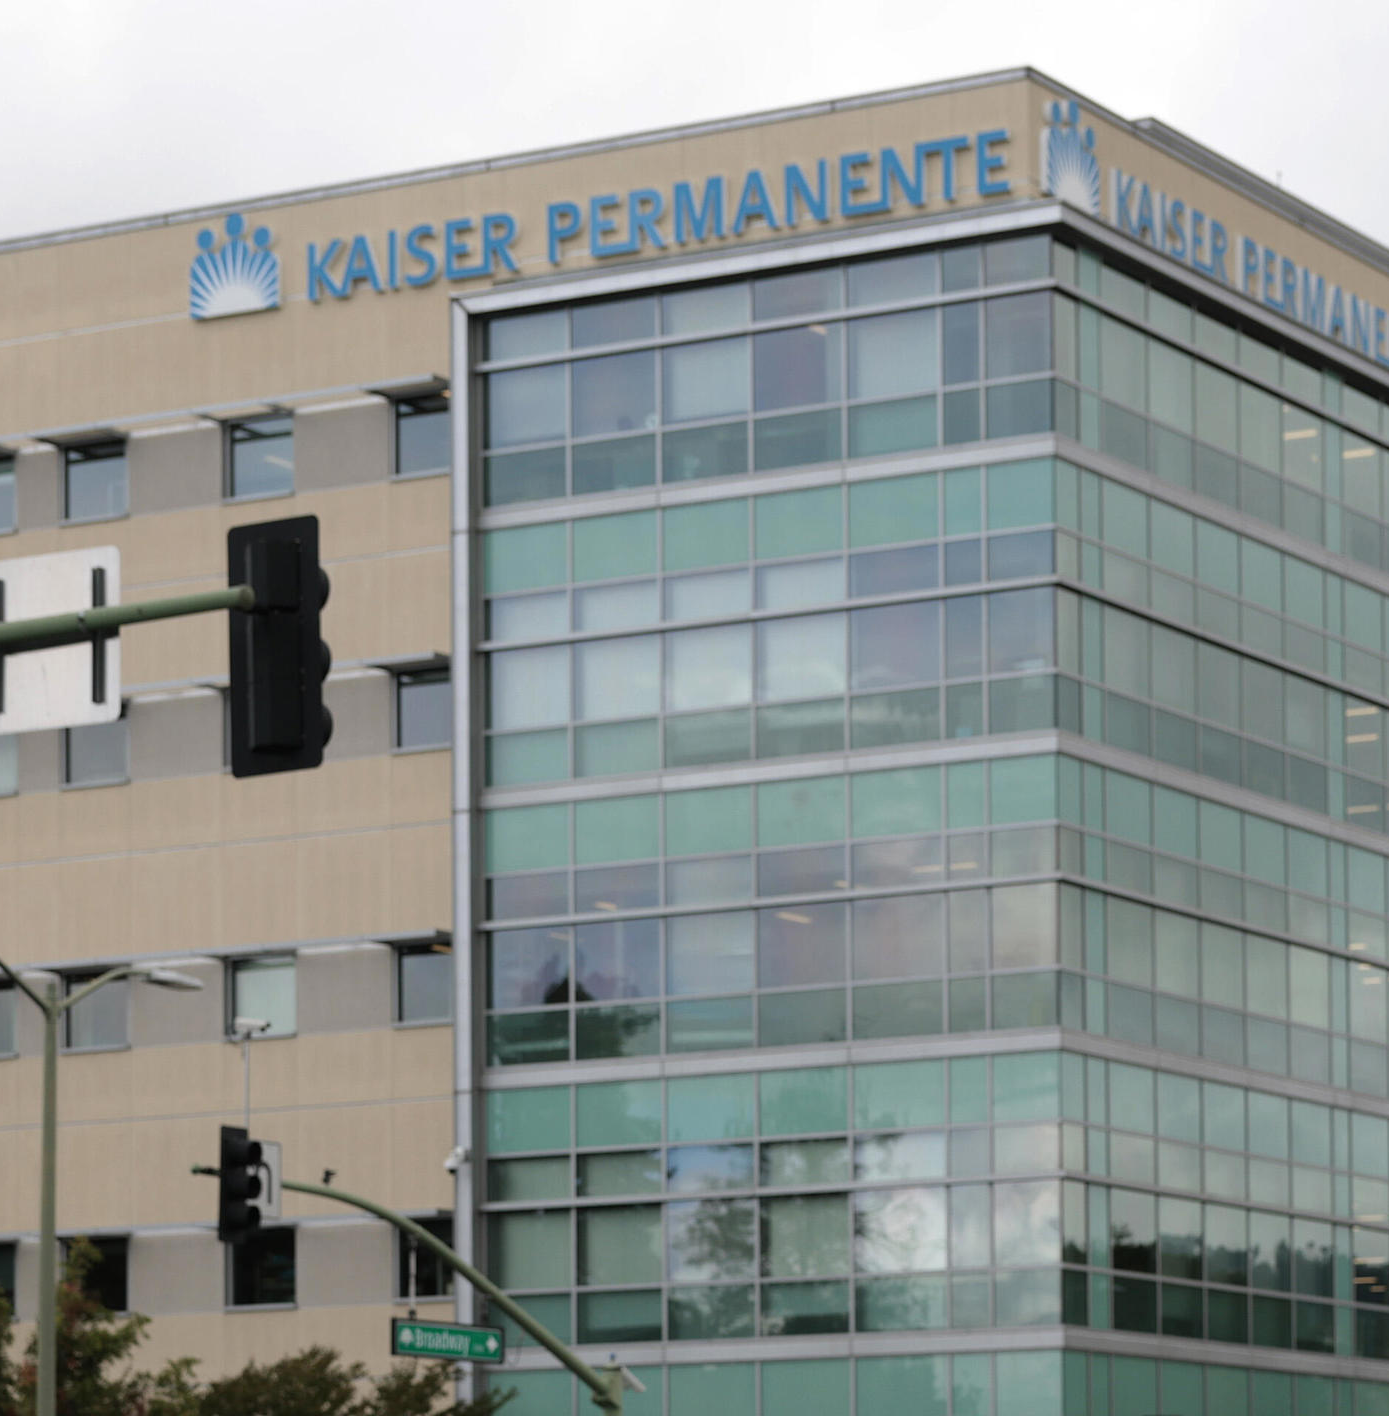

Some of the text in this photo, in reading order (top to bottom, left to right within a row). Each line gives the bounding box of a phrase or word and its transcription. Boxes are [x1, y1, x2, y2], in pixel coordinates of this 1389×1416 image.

[308, 129, 1011, 301] KAISER PERMANENTE
[1114, 168, 1227, 276] KAISER
[414, 1327, 471, 1358] Broadway
